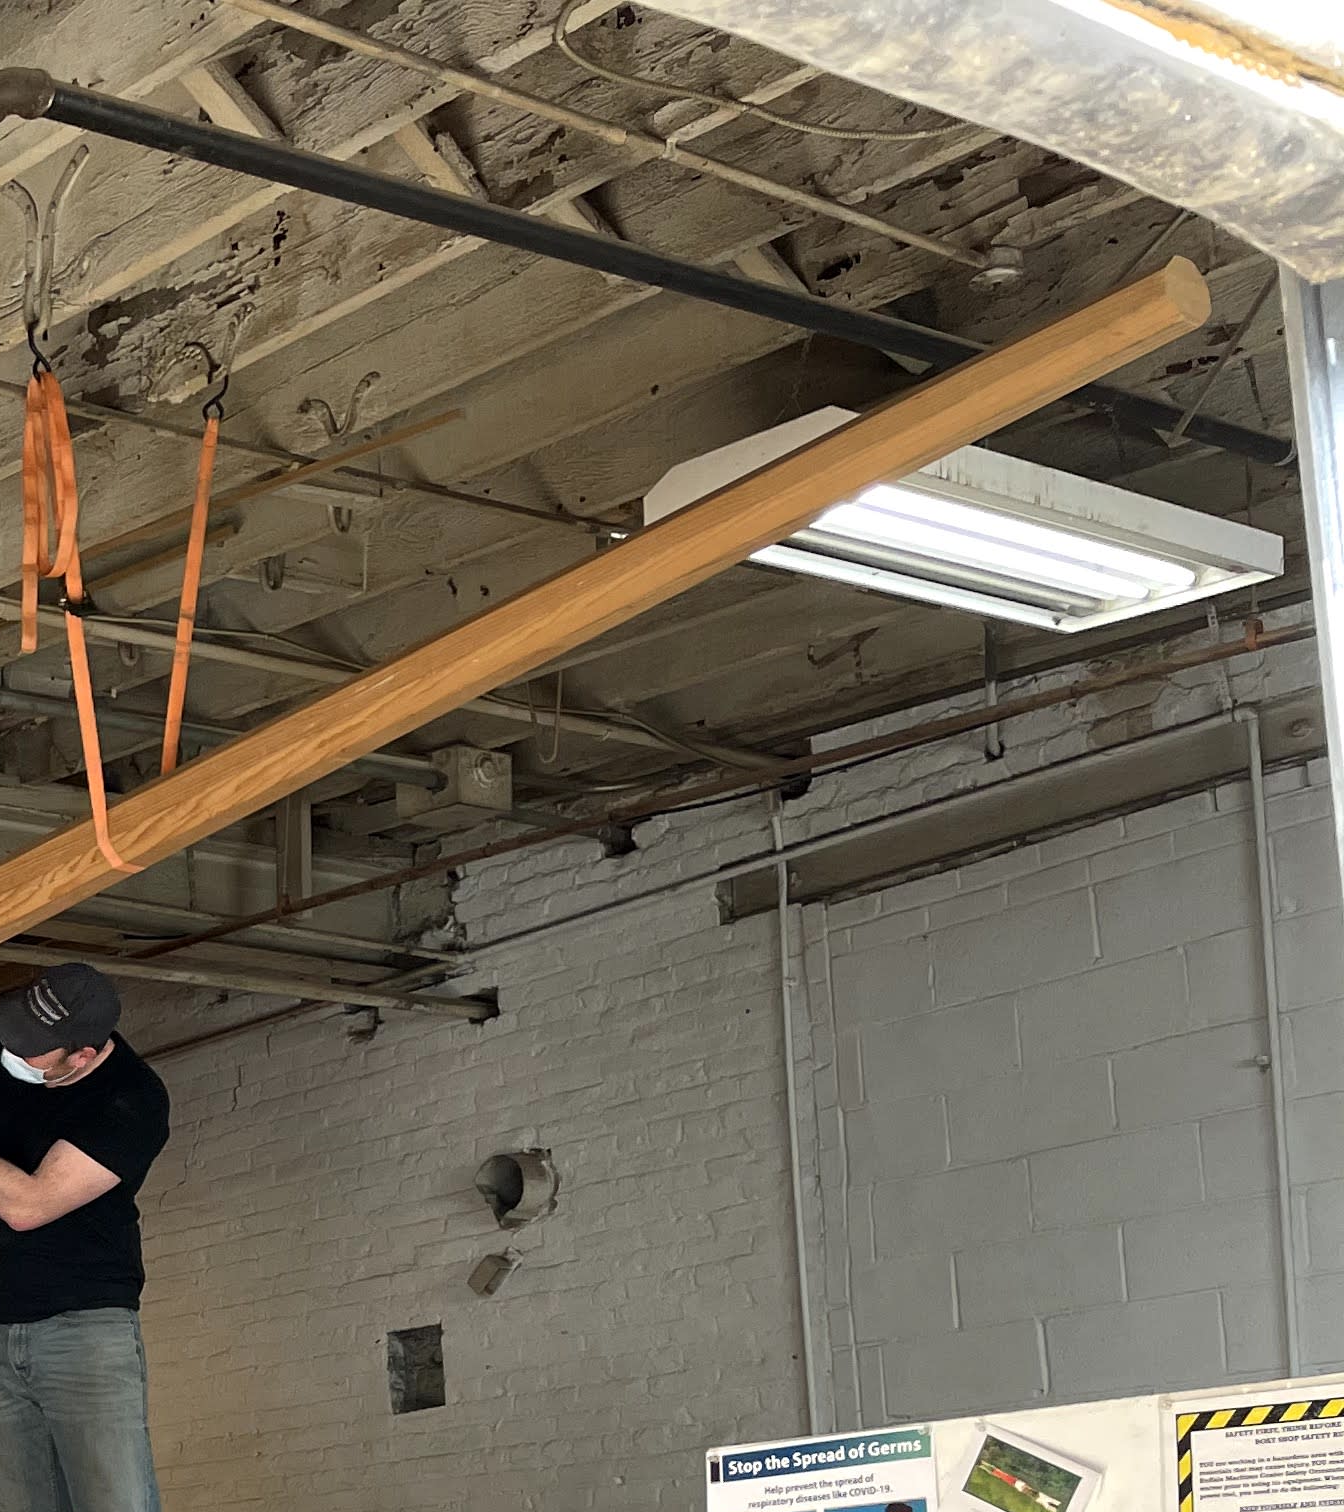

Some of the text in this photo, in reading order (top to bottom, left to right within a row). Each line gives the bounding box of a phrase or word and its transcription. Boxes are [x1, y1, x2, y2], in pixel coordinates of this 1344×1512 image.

[728, 1439, 921, 1476] Stop the Spread of Germs
[765, 1473, 874, 1495] Help prevent the spread of
[748, 1498, 793, 1510] respiratory
[795, 1494, 831, 1504] diseases
[832, 1490, 847, 1499] like
